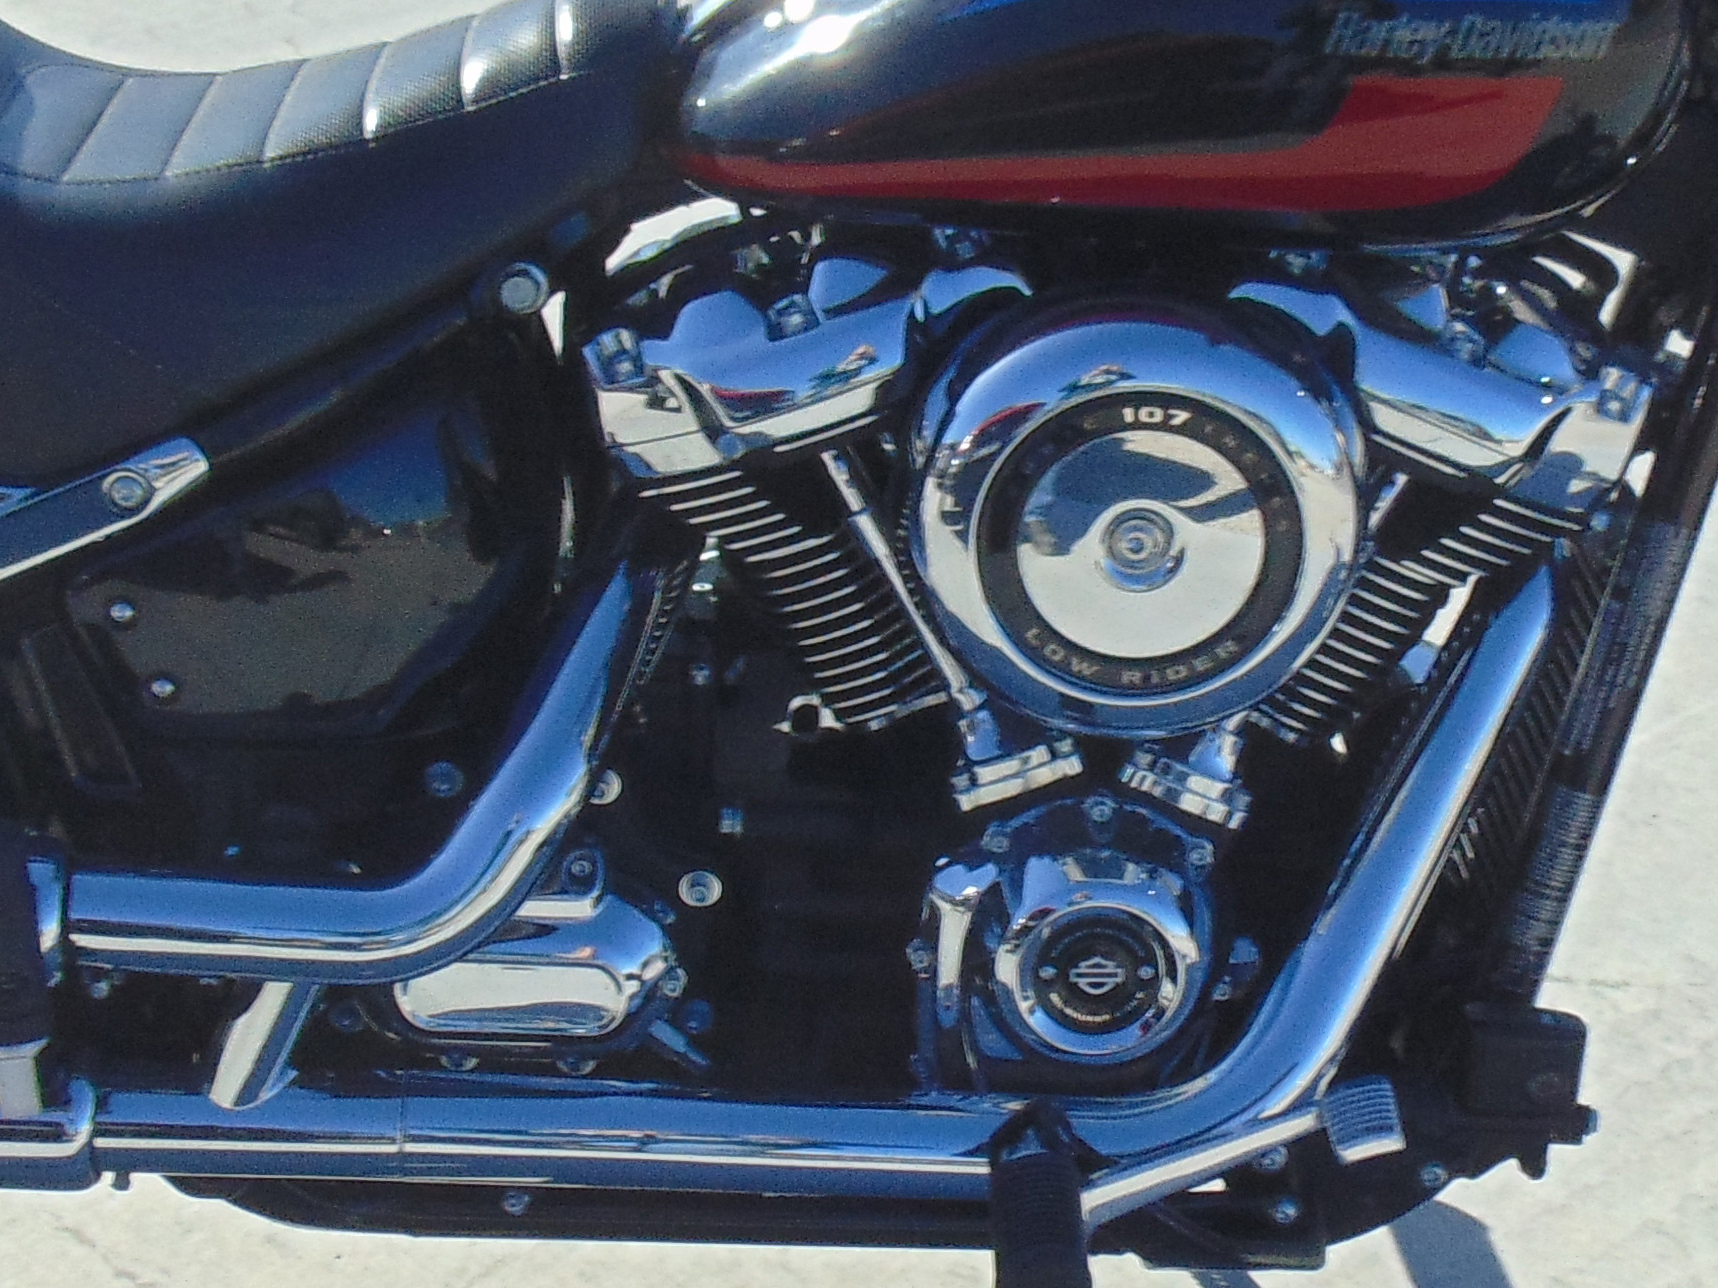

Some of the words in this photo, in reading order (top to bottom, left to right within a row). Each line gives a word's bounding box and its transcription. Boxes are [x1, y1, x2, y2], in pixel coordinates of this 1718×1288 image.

[1121, 406, 1193, 426] 107
[1025, 627, 1103, 676] LOW
[1120, 639, 1238, 686] RIDER
